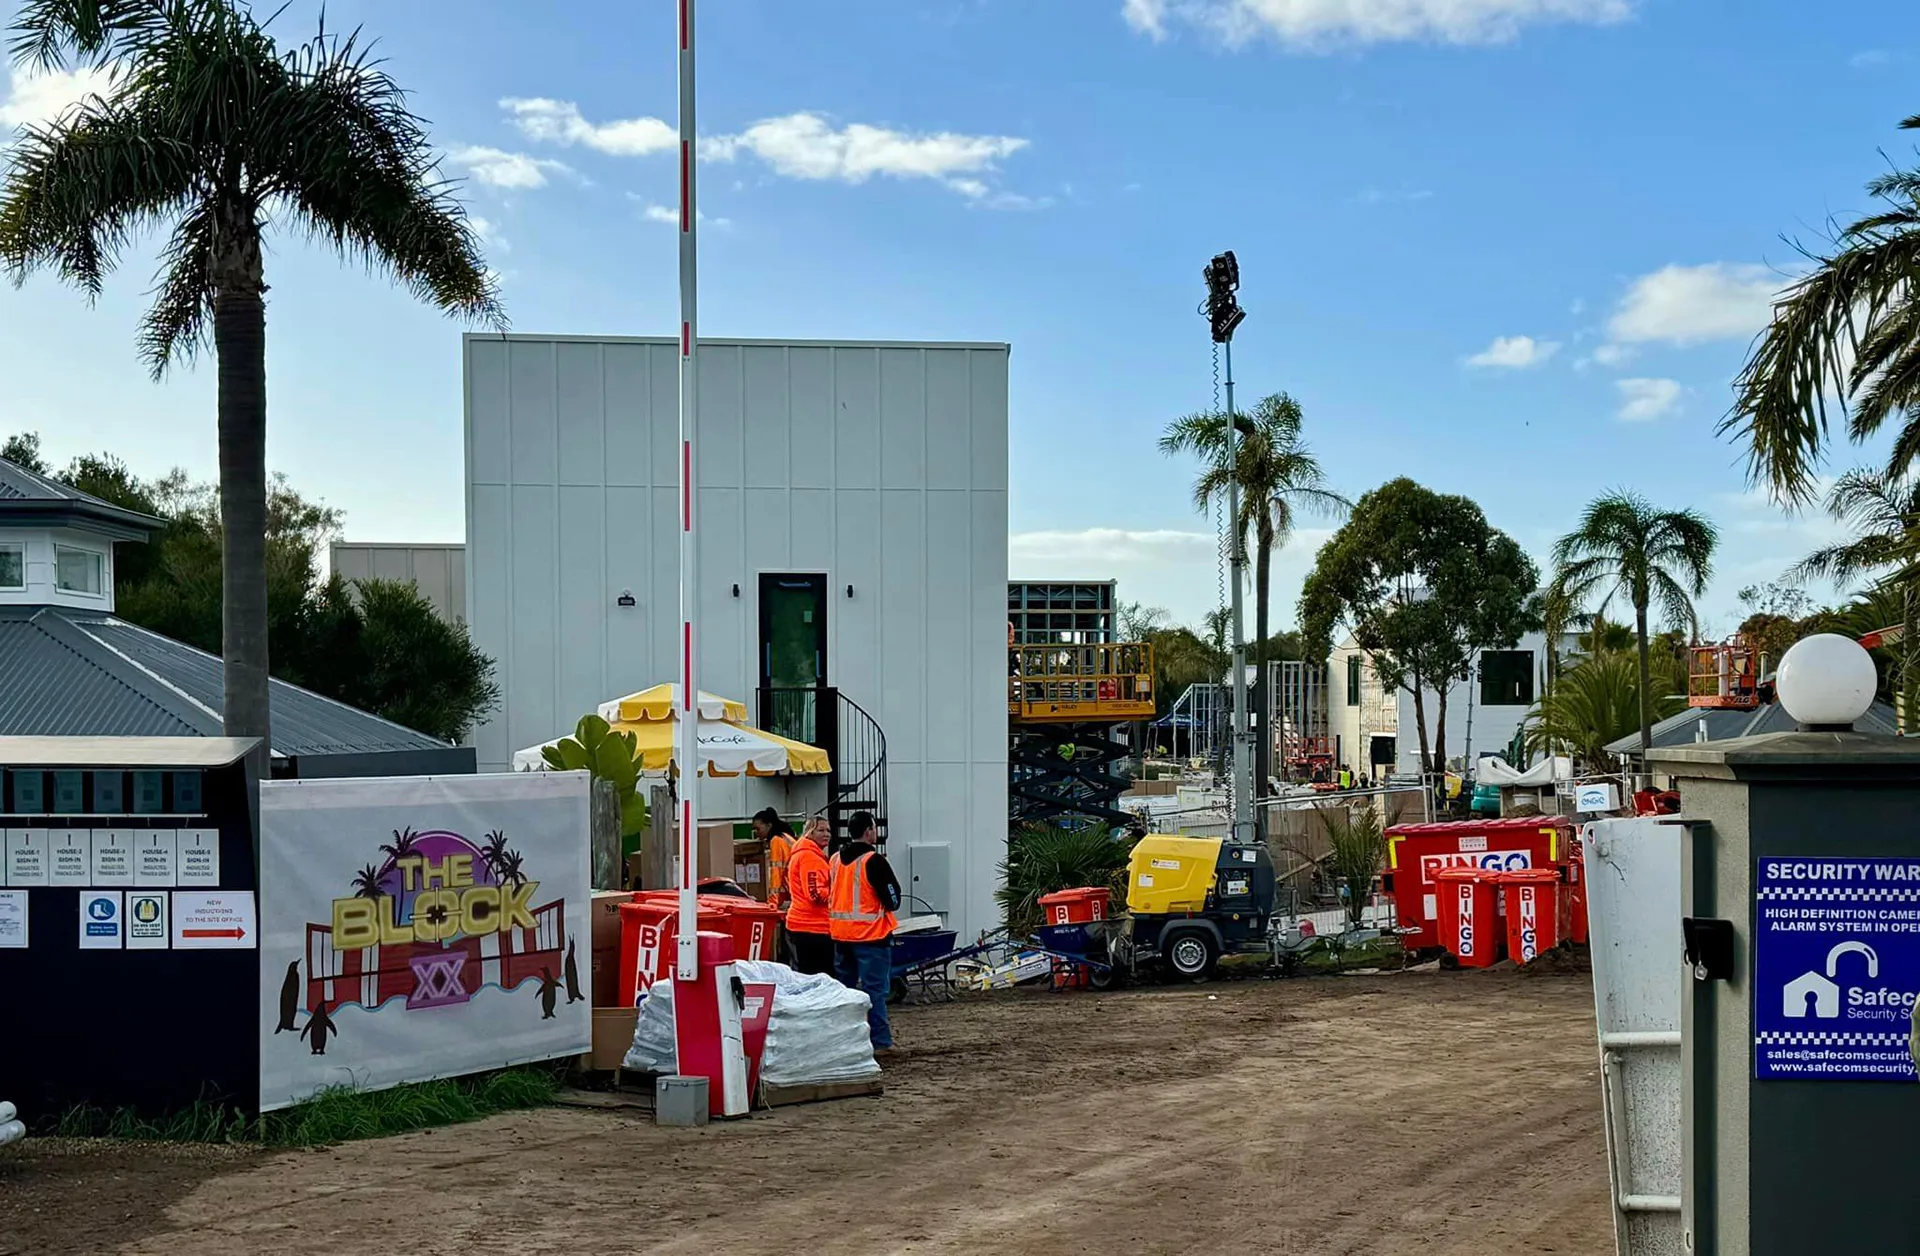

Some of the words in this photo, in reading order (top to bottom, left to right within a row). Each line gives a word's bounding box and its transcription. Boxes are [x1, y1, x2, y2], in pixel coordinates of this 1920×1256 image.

[397, 854, 474, 891] THE
[1767, 863, 1871, 881] SECURITY
[1875, 864, 1920, 881] WAR
[332, 881, 541, 951] BLOCK
[1460, 886, 1472, 954] BINGO
[1521, 888, 1536, 959] BINGO
[1766, 908, 1799, 919] HIGH
[1801, 909, 1877, 920] DEFINITION
[1771, 921, 1817, 932] ALARM
[1819, 922, 1872, 932] SYSTEM
[1875, 923, 1889, 932] IN
[413, 958, 466, 1001] XX
[1847, 1007, 1897, 1021] Security
[1900, 1008, 1911, 1019] S
